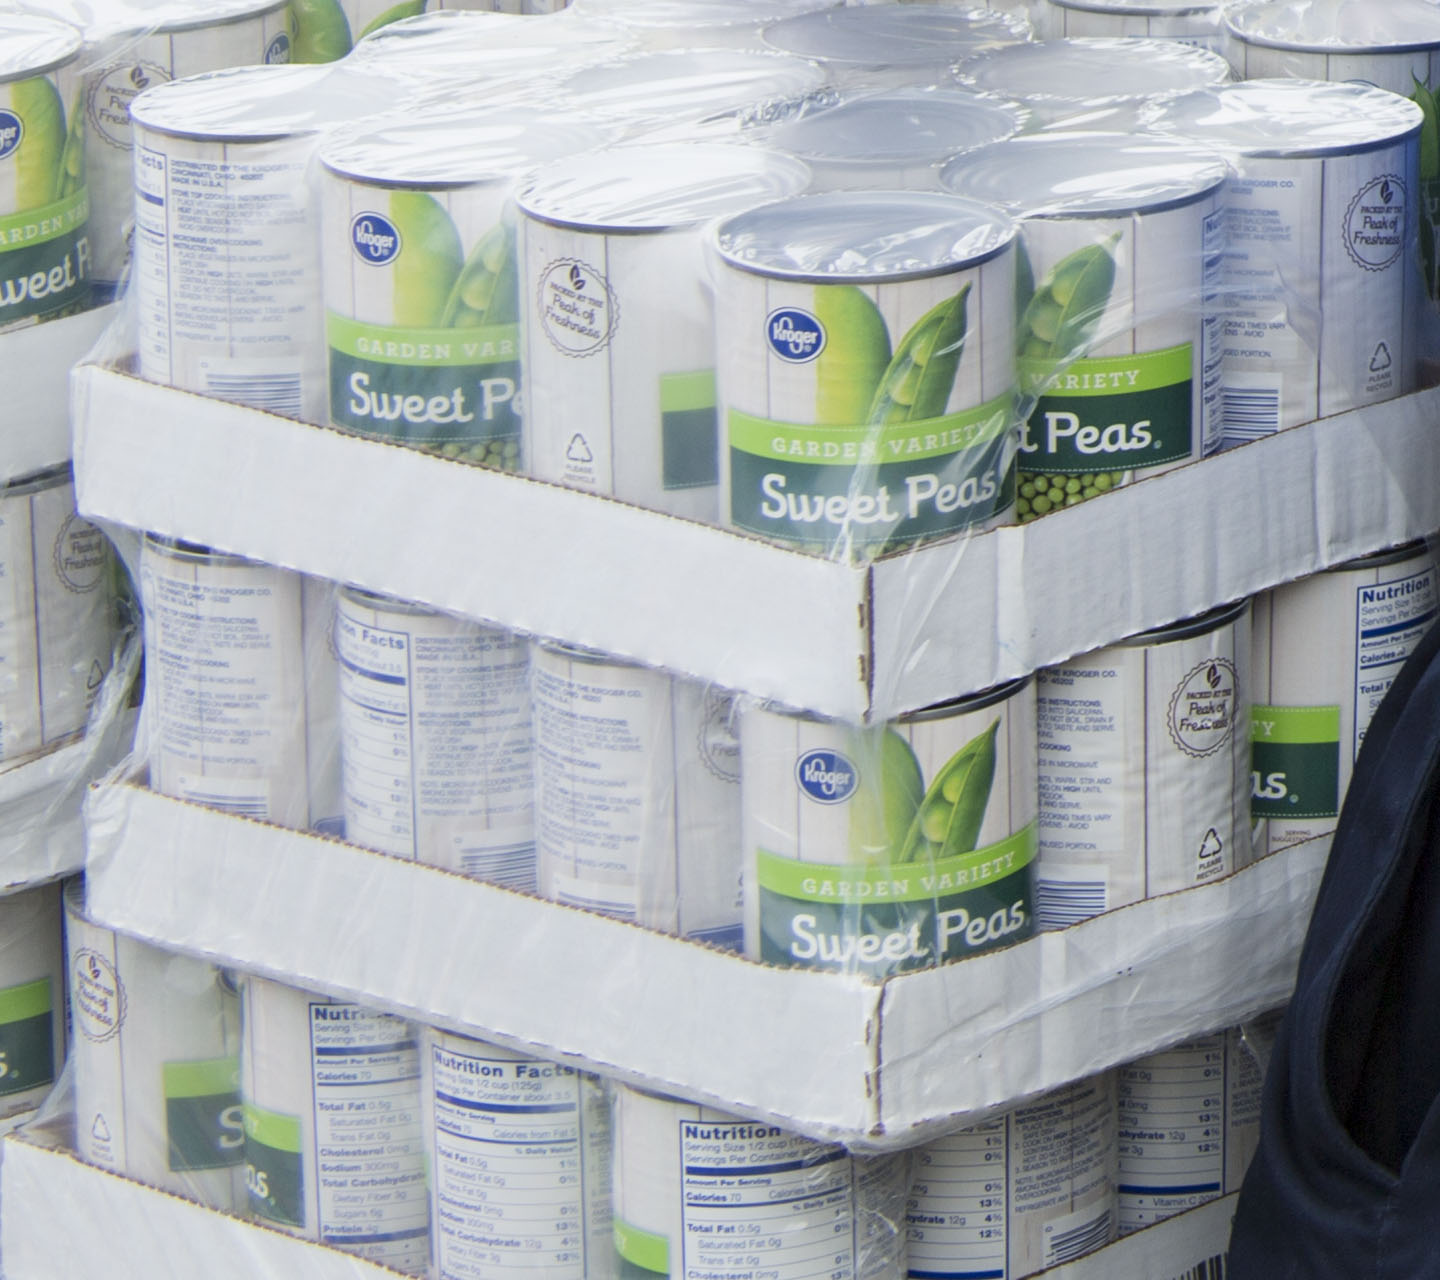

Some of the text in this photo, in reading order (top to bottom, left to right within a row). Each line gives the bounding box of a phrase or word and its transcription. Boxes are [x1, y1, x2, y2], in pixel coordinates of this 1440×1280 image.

[1363, 216, 1398, 233] Peak of
[356, 220, 395, 256] Kroger
[1354, 232, 1402, 246] Freshness
[0, 253, 76, 307] weet
[552, 294, 595, 325] Peak of
[545, 304, 601, 340] Freshness
[1247, 321, 1286, 330] TIMES VARY
[773, 316, 818, 353] Kroger
[1244, 329, 1265, 338] AVOID
[356, 336, 451, 359] GARDEN
[1031, 369, 1141, 389] VARIETY
[349, 371, 473, 423] Sweet
[1044, 411, 1152, 454] Peas
[771, 420, 988, 459] GARDEN VARIETY
[761, 470, 997, 524] Sweet Peas
[1361, 576, 1431, 604] Nutrition
[1361, 599, 1411, 616] Serving Size
[1361, 611, 1411, 627] Servings Per
[363, 629, 405, 649] Facts
[1360, 650, 1396, 664] Calories
[1063, 670, 1100, 678] KROGER
[1360, 681, 1384, 695] Total
[1189, 700, 1227, 717] Peak of
[804, 758, 851, 795] Kroger
[1094, 813, 1112, 822] VARY
[1069, 822, 1090, 830] AVOID
[1199, 856, 1222, 870] PLEASE
[801, 851, 1016, 897] GARDEN VARIETY
[1197, 865, 1225, 881] RECYCLE
[791, 899, 1025, 963] Sweet Peas
[1205, 1053, 1221, 1063] 1%
[434, 1052, 575, 1079] Nutrition Facts
[317, 1071, 358, 1081] Calories
[1203, 1068, 1221, 1077] 0%
[491, 1081, 509, 1091] cup
[476, 1089, 521, 1102] Container
[319, 1101, 366, 1111] Total Fat
[1203, 1098, 1221, 1108] 0%
[1198, 1113, 1221, 1123] 13%
[685, 1125, 782, 1140] Nutrition
[1168, 1128, 1221, 1141] 12g 4%
[685, 1140, 764, 1153] Serving Size 1/2
[985, 1136, 1002, 1146] 1%
[320, 1147, 385, 1157] Cholesterol
[1132, 1143, 1221, 1156] 3g 12%
[685, 1153, 727, 1165] Servings
[729, 1152, 746, 1164] Per
[984, 1152, 1002, 1162] 0%
[321, 1163, 361, 1172] Sodium
[322, 1178, 348, 1188] Total
[720, 1178, 735, 1187] Per
[984, 1183, 1002, 1193] 0%
[685, 1192, 742, 1202] Calories 70
[979, 1197, 1002, 1208] 13%
[1152, 1195, 1197, 1207] Vitamin C
[949, 1213, 1002, 1226] 12g 4%
[323, 1224, 362, 1234] Protein
[688, 1223, 760, 1235] Total Fat 0.5g
[978, 1229, 1002, 1239] 12%
[457, 1229, 521, 1247] Carbohydrate
[698, 1237, 782, 1250] Saturated Fat 0g
[699, 1255, 760, 1267] Trans Fat 0g
[688, 1270, 753, 1280] Cholesterol
